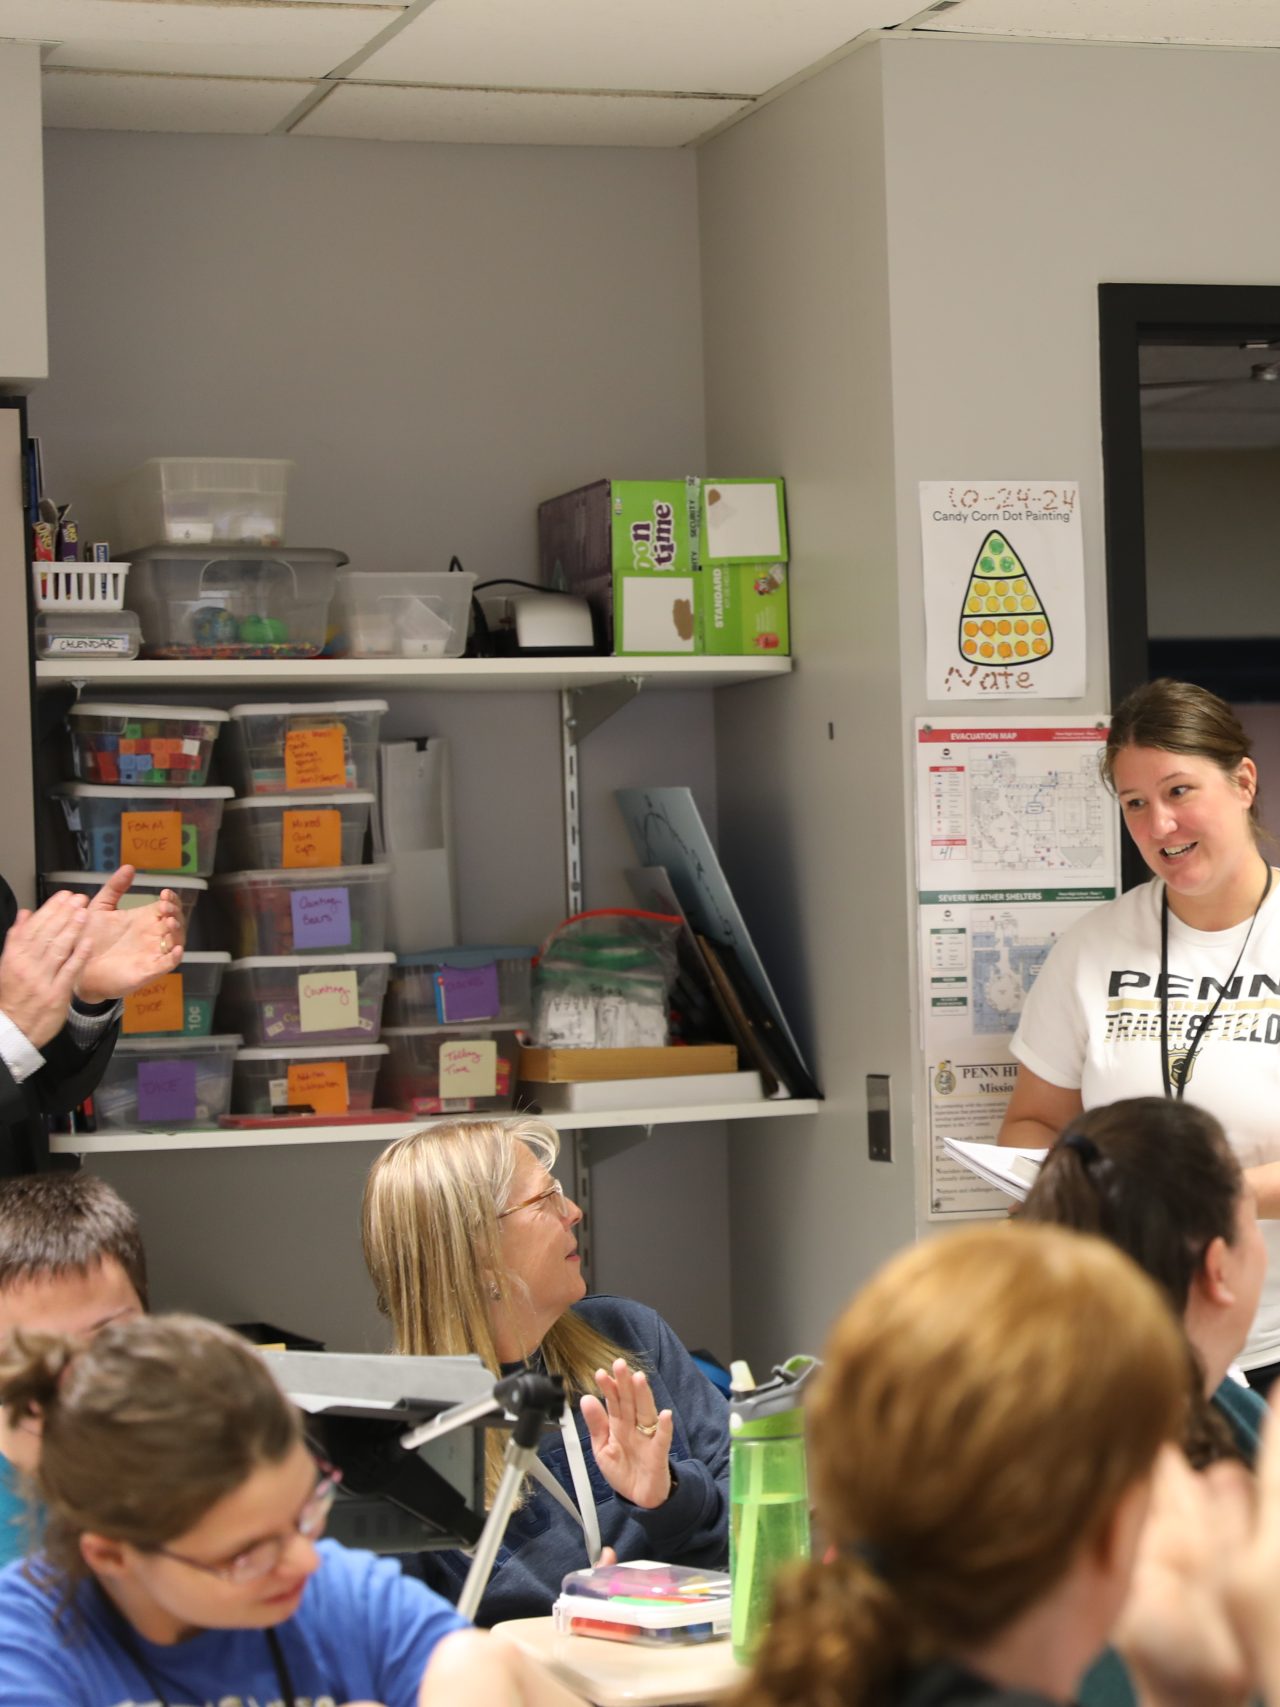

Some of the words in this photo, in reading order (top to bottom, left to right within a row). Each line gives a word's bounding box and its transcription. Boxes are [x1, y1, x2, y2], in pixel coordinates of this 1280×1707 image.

[689, 500, 697, 538] SECURITY
[932, 511, 968, 523] Candy
[971, 511, 999, 521] Corn
[1003, 510, 1023, 521] Dot
[1026, 511, 1070, 522] Painting
[653, 503, 676, 567] time
[713, 568, 724, 628] STANDARD
[945, 666, 1034, 691] Nate
[951, 733, 998, 741] EVACUATION
[1000, 732, 1017, 740] MAP
[132, 836, 169, 851] DICE
[938, 893, 967, 903] SEVERE
[968, 893, 1004, 902] WEATHER
[1005, 892, 1042, 901] SHELTERS
[963, 1067, 999, 1079] PENN
